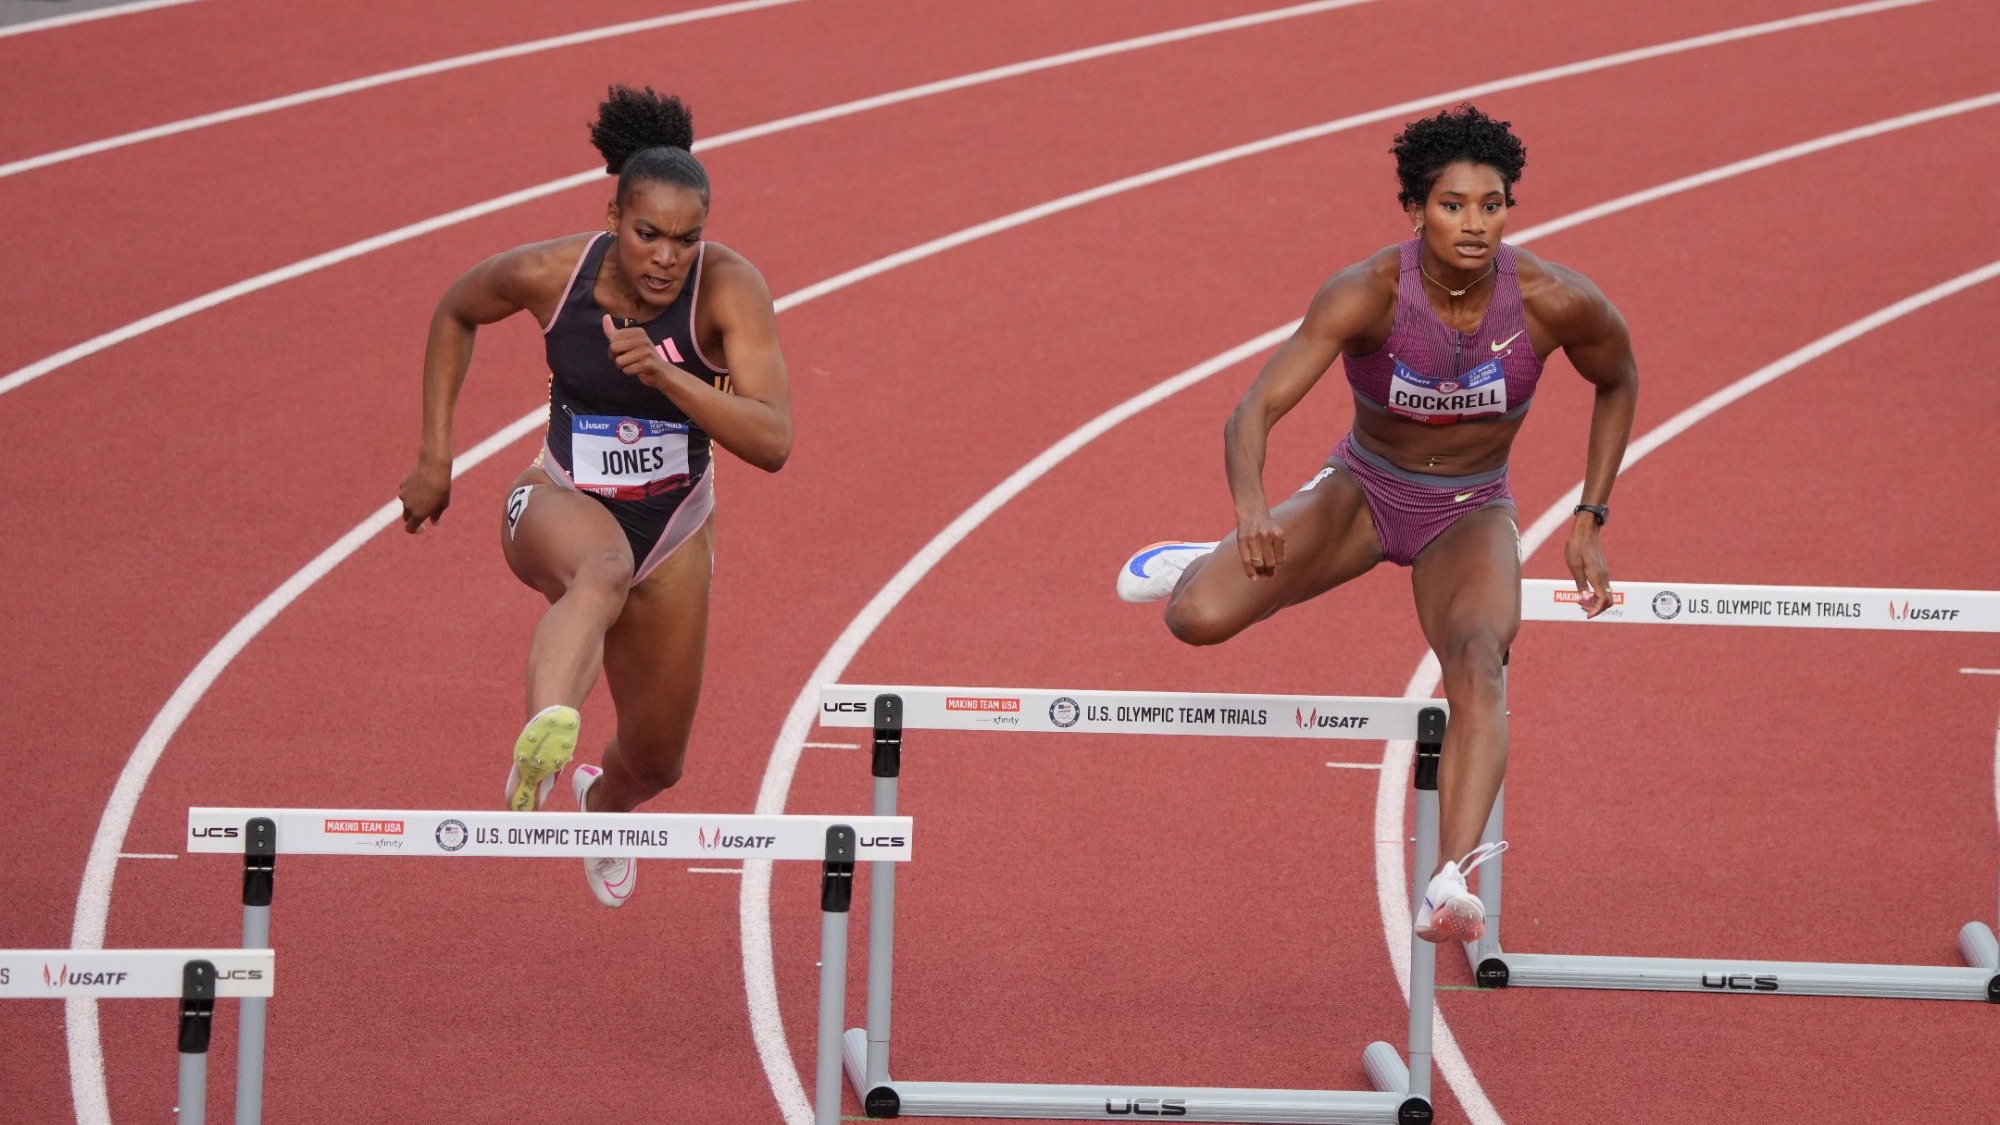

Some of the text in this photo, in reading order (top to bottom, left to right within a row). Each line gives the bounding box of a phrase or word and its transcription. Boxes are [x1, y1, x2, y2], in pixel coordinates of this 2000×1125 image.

[1395, 389, 1501, 410] COCKRELL
[601, 446, 664, 476] JONES
[1556, 592, 1582, 601] MAKIN
[1688, 599, 1712, 614] U.S.
[1717, 600, 1772, 615] OLYMPIC
[1776, 601, 1811, 616] TEAM
[1816, 602, 1861, 618] TRIALS
[1910, 609, 1960, 620] USATF
[824, 702, 867, 712] UCS
[948, 699, 1018, 710] MAKING TEAM USA
[992, 715, 1019, 725] xfinity
[1087, 706, 1112, 721] U.S.
[1117, 706, 1174, 722] OLYMPIC
[1179, 708, 1215, 723] TEAM
[1220, 709, 1267, 725] TRIALS
[1317, 715, 1369, 729] USATF
[192, 827, 239, 838] UCS
[327, 821, 402, 833] MAKING TEAM USA
[476, 828, 502, 844] U.S.
[508, 828, 569, 845] OLYMPIC
[574, 829, 613, 846] TEAM
[618, 829, 668, 846] TRIALS
[721, 836, 776, 849] USATF
[860, 837, 905, 847] UCS
[374, 839, 403, 849] xfinity
[69, 972, 127, 986] USATF
[215, 970, 262, 980] UCS
[1702, 972, 1779, 991] UCS
[1106, 1098, 1187, 1116] UCS
